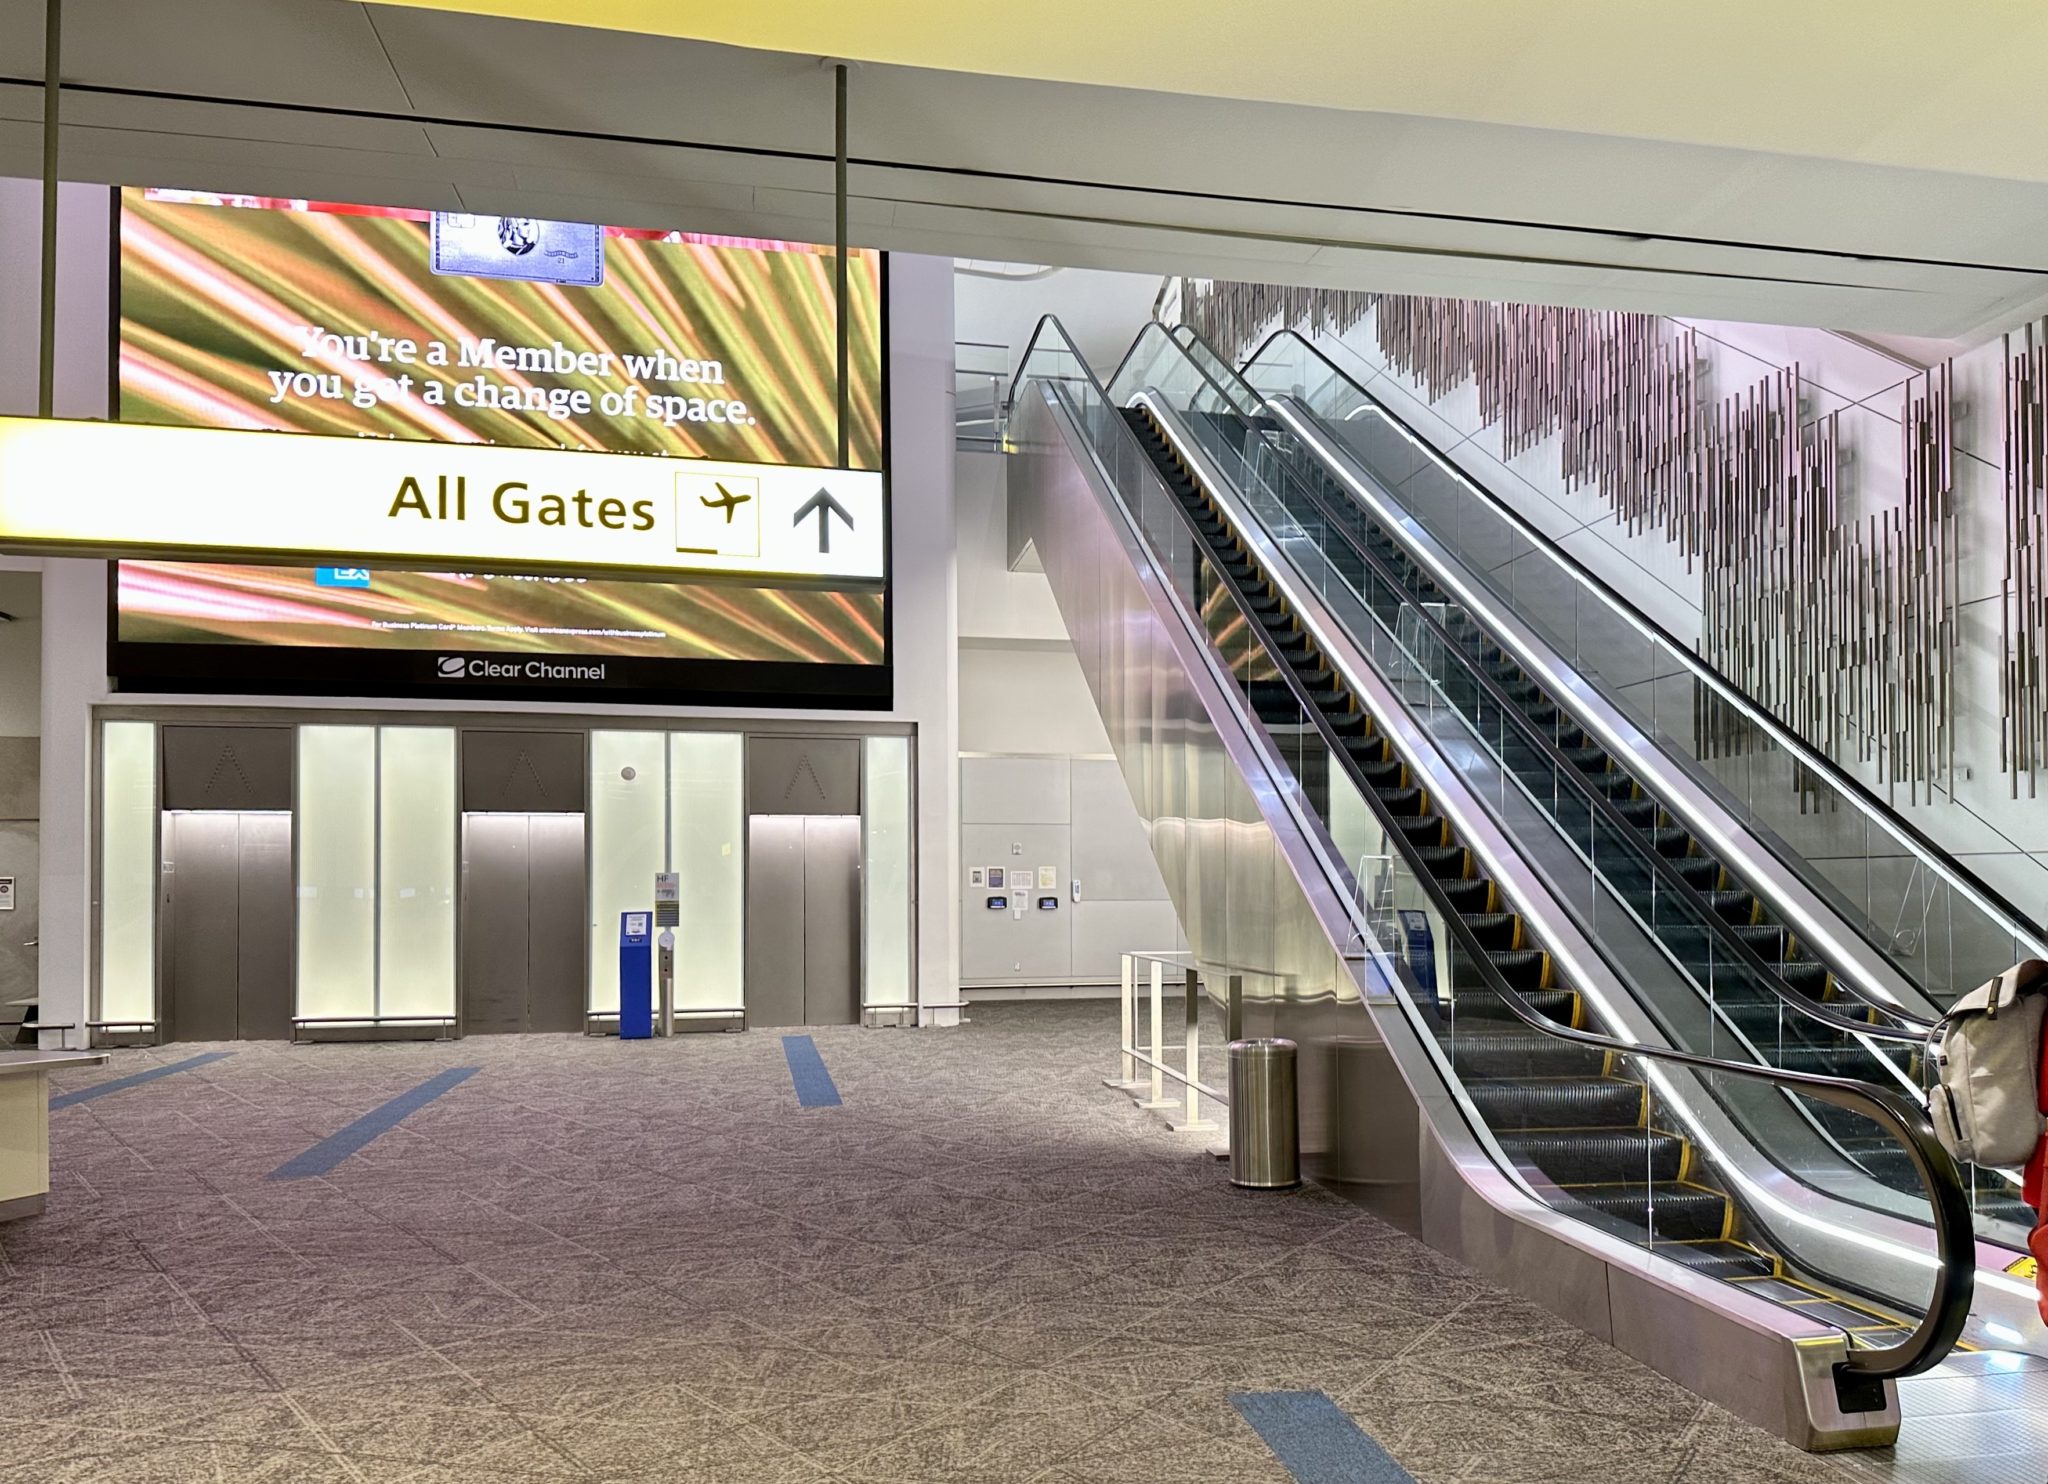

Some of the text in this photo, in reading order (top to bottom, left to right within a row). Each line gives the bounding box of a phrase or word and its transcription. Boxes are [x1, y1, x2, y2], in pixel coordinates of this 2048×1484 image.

[299, 325, 725, 386] You're a Member when
[268, 370, 757, 427] you get a change of space.
[388, 475, 655, 531] All Gates
[383, 621, 410, 629] Business
[411, 622, 437, 630] Platinum
[468, 660, 605, 680] Clear Channel
